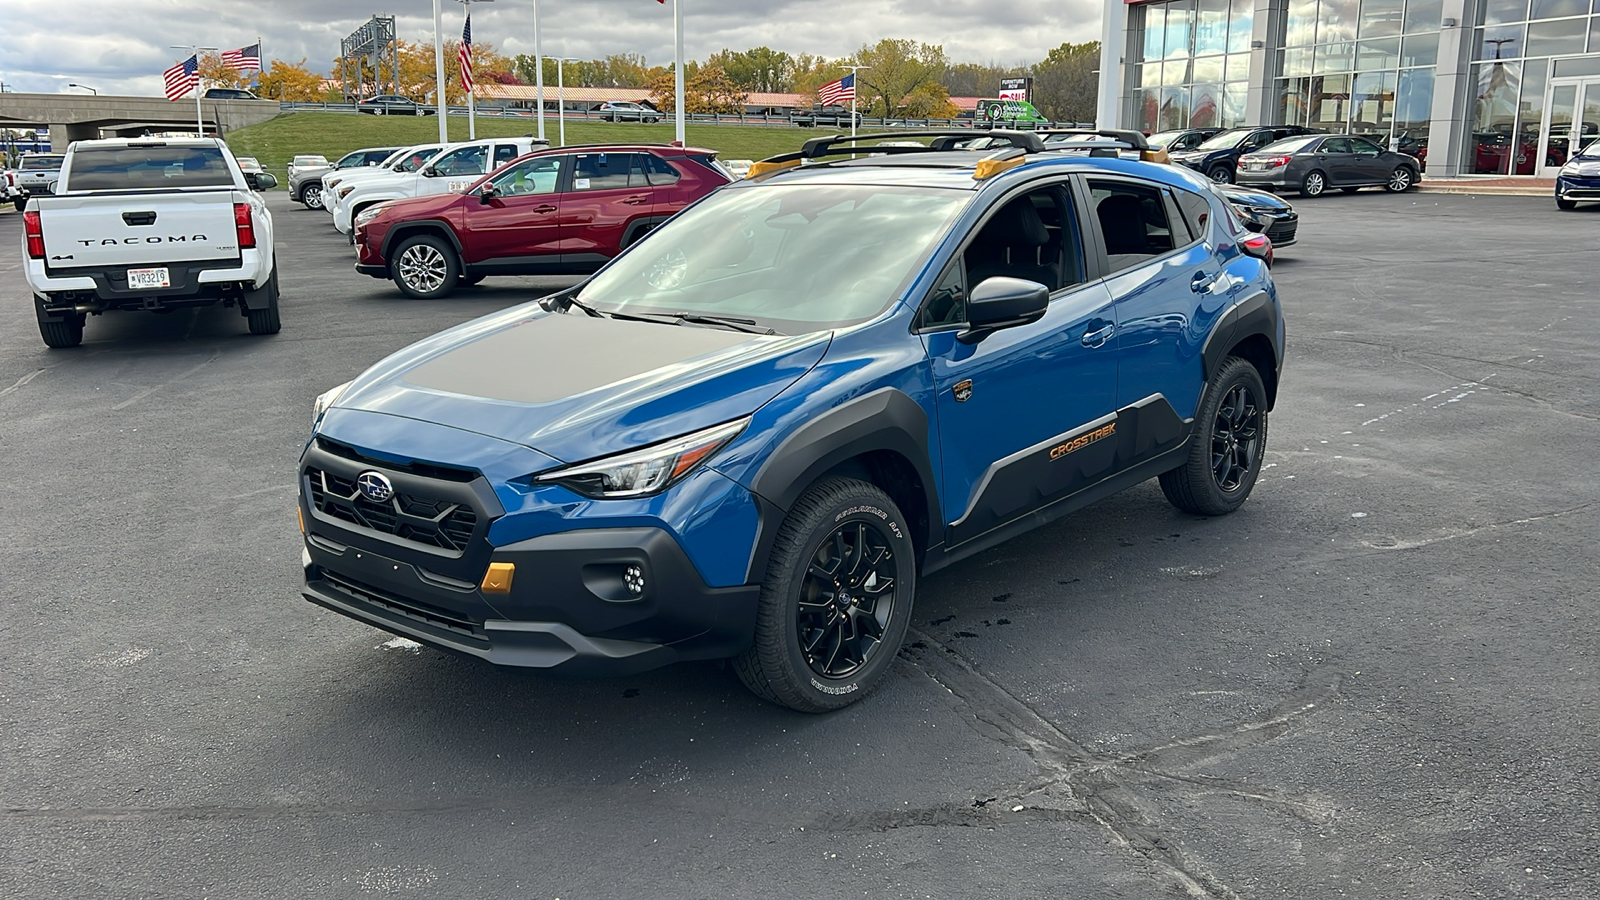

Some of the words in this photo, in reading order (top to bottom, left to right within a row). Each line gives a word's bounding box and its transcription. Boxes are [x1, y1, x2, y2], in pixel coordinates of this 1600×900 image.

[77, 234, 208, 246] TACOMA
[137, 272, 165, 284] VR3219
[1049, 422, 1116, 459] CROSSTREK
